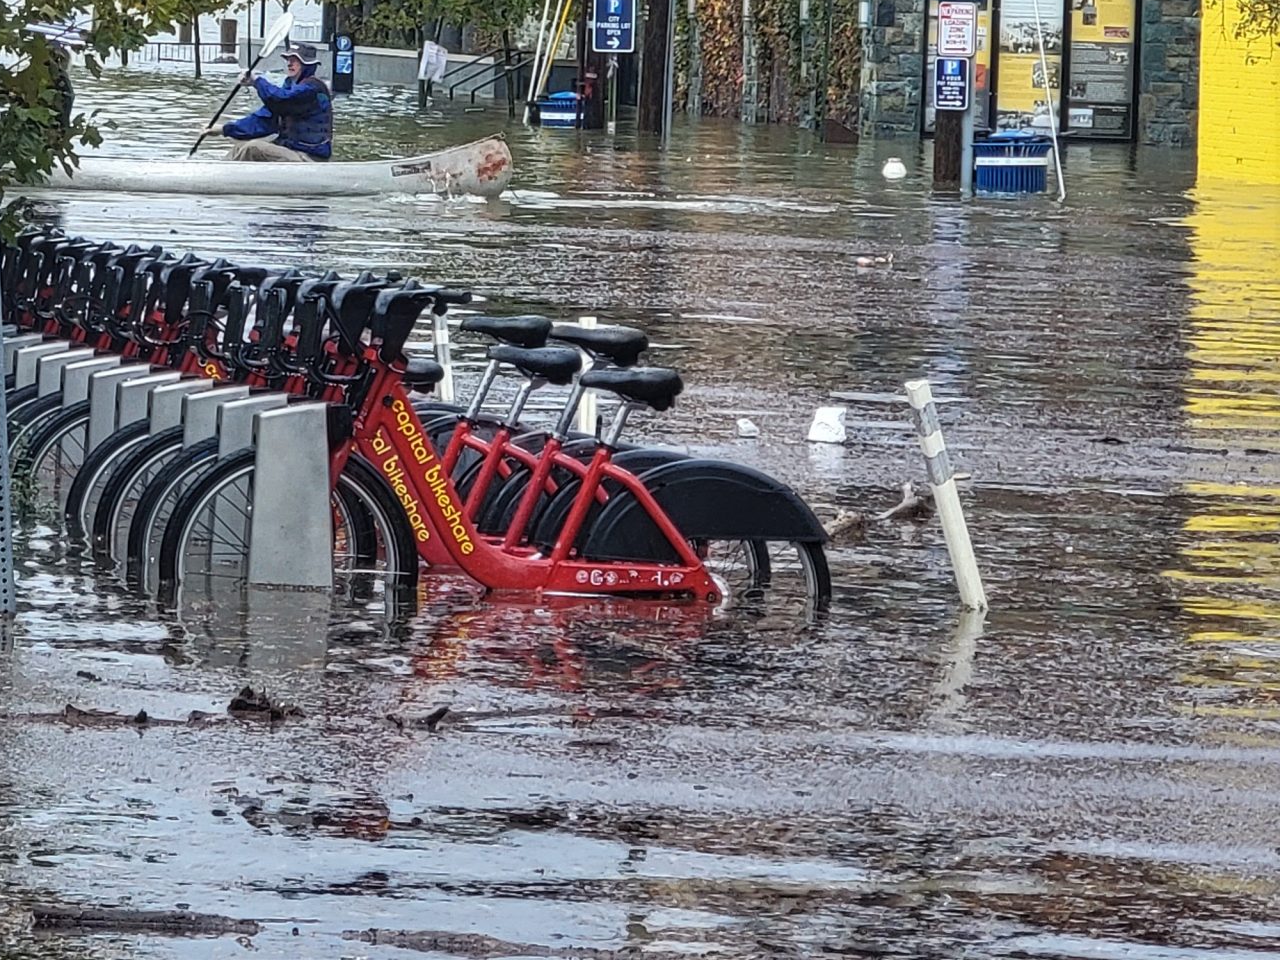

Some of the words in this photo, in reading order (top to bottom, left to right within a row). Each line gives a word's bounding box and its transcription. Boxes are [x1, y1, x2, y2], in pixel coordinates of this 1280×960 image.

[609, 0, 620, 13] P
[597, 22, 620, 30] PARKING
[606, 29, 622, 37] OPEN
[947, 60, 958, 75] P
[391, 399, 433, 466] capital
[424, 463, 475, 556] bikeshare
[382, 454, 430, 542] bikeshare
